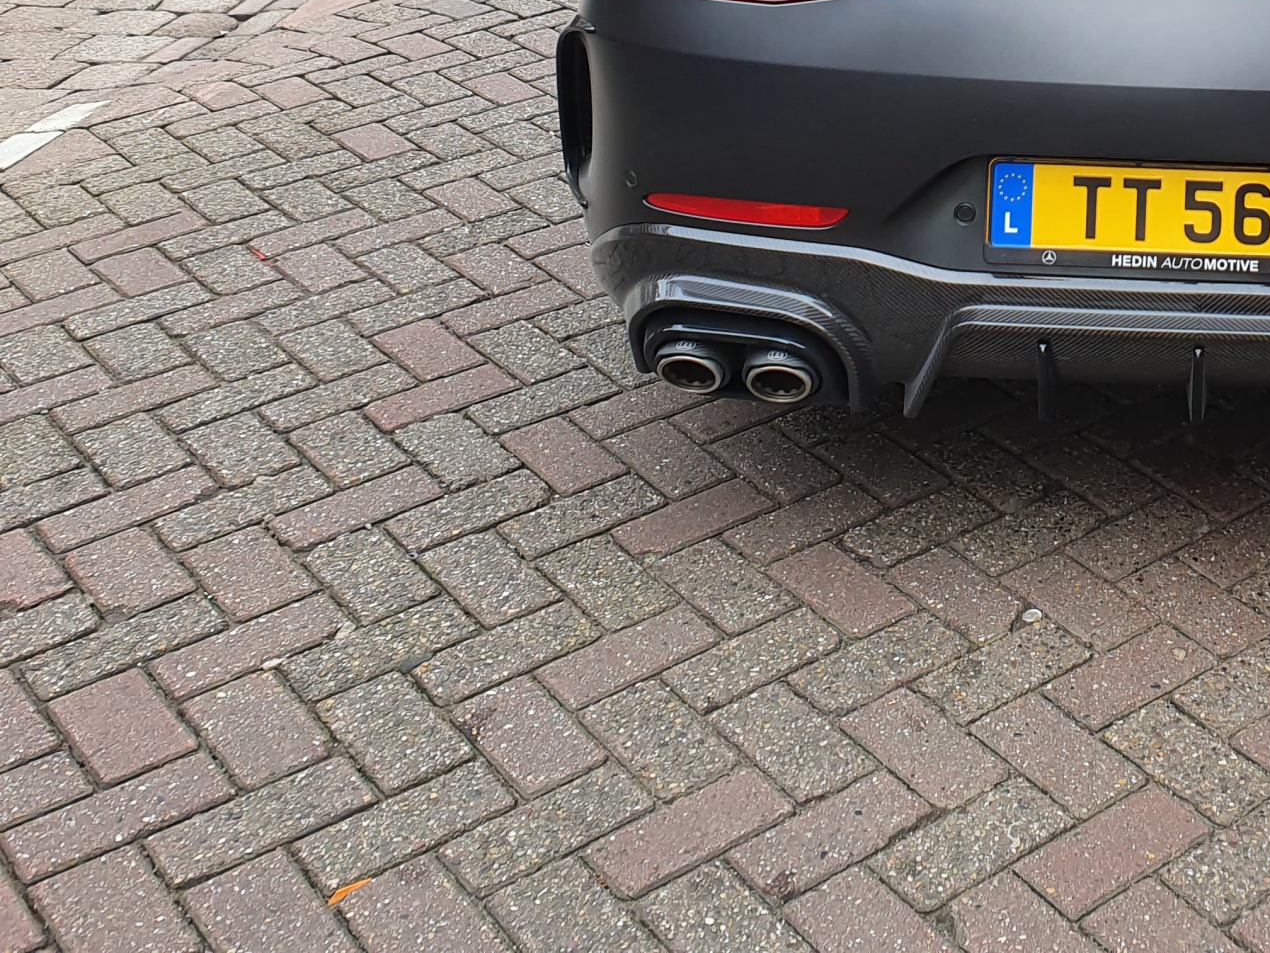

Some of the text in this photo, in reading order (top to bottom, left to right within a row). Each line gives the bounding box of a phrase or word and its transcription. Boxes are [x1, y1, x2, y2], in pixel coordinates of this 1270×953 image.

[1073, 175, 1162, 242] TT
[1004, 212, 1018, 234] L
[1111, 254, 1158, 269] HEDIN
